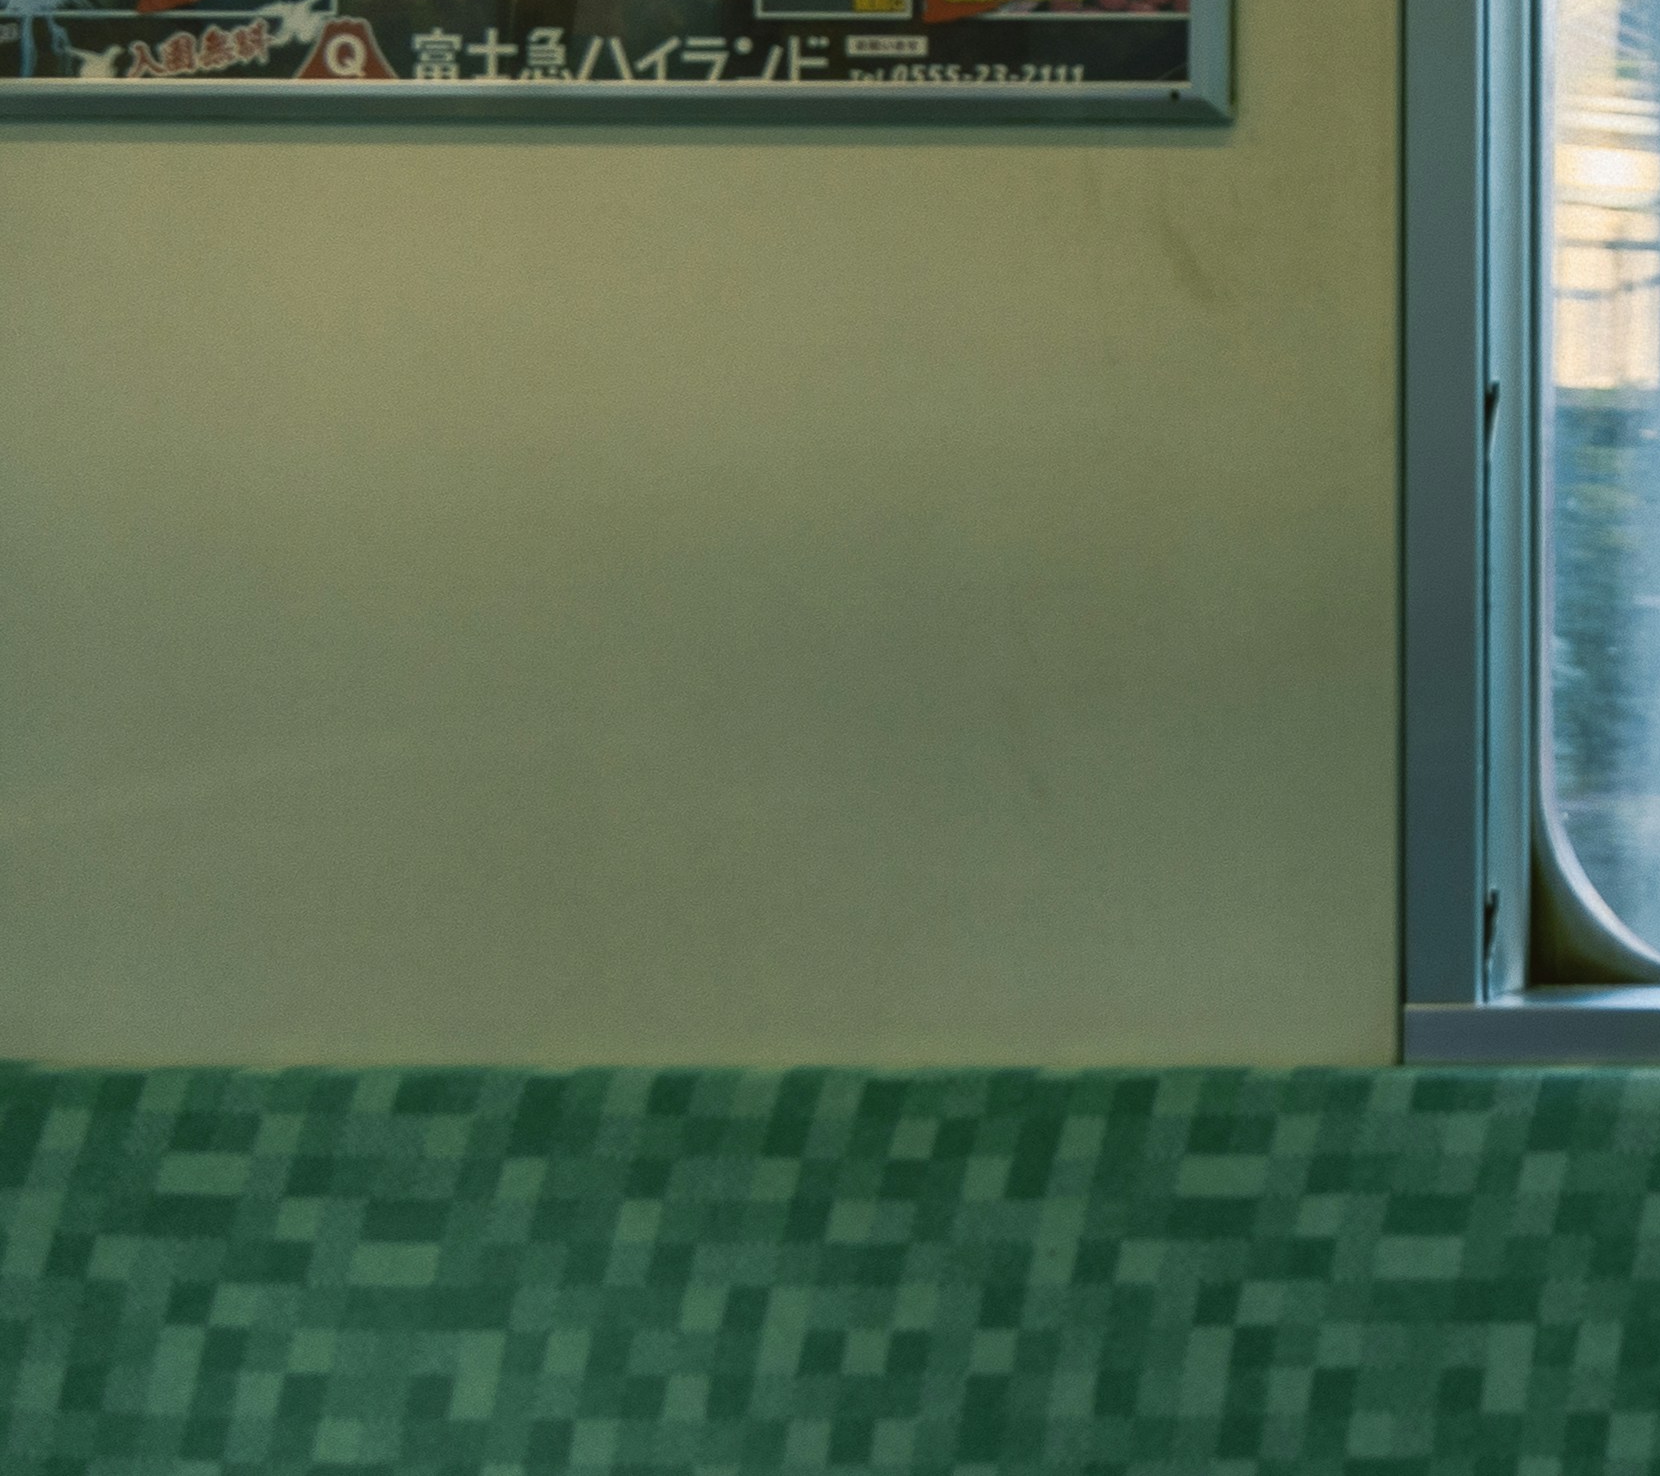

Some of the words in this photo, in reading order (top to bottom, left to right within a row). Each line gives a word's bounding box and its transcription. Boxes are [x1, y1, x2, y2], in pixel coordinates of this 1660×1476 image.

[127, 18, 270, 78] 入園無料
[411, 27, 830, 80] 富士急ハイランド
